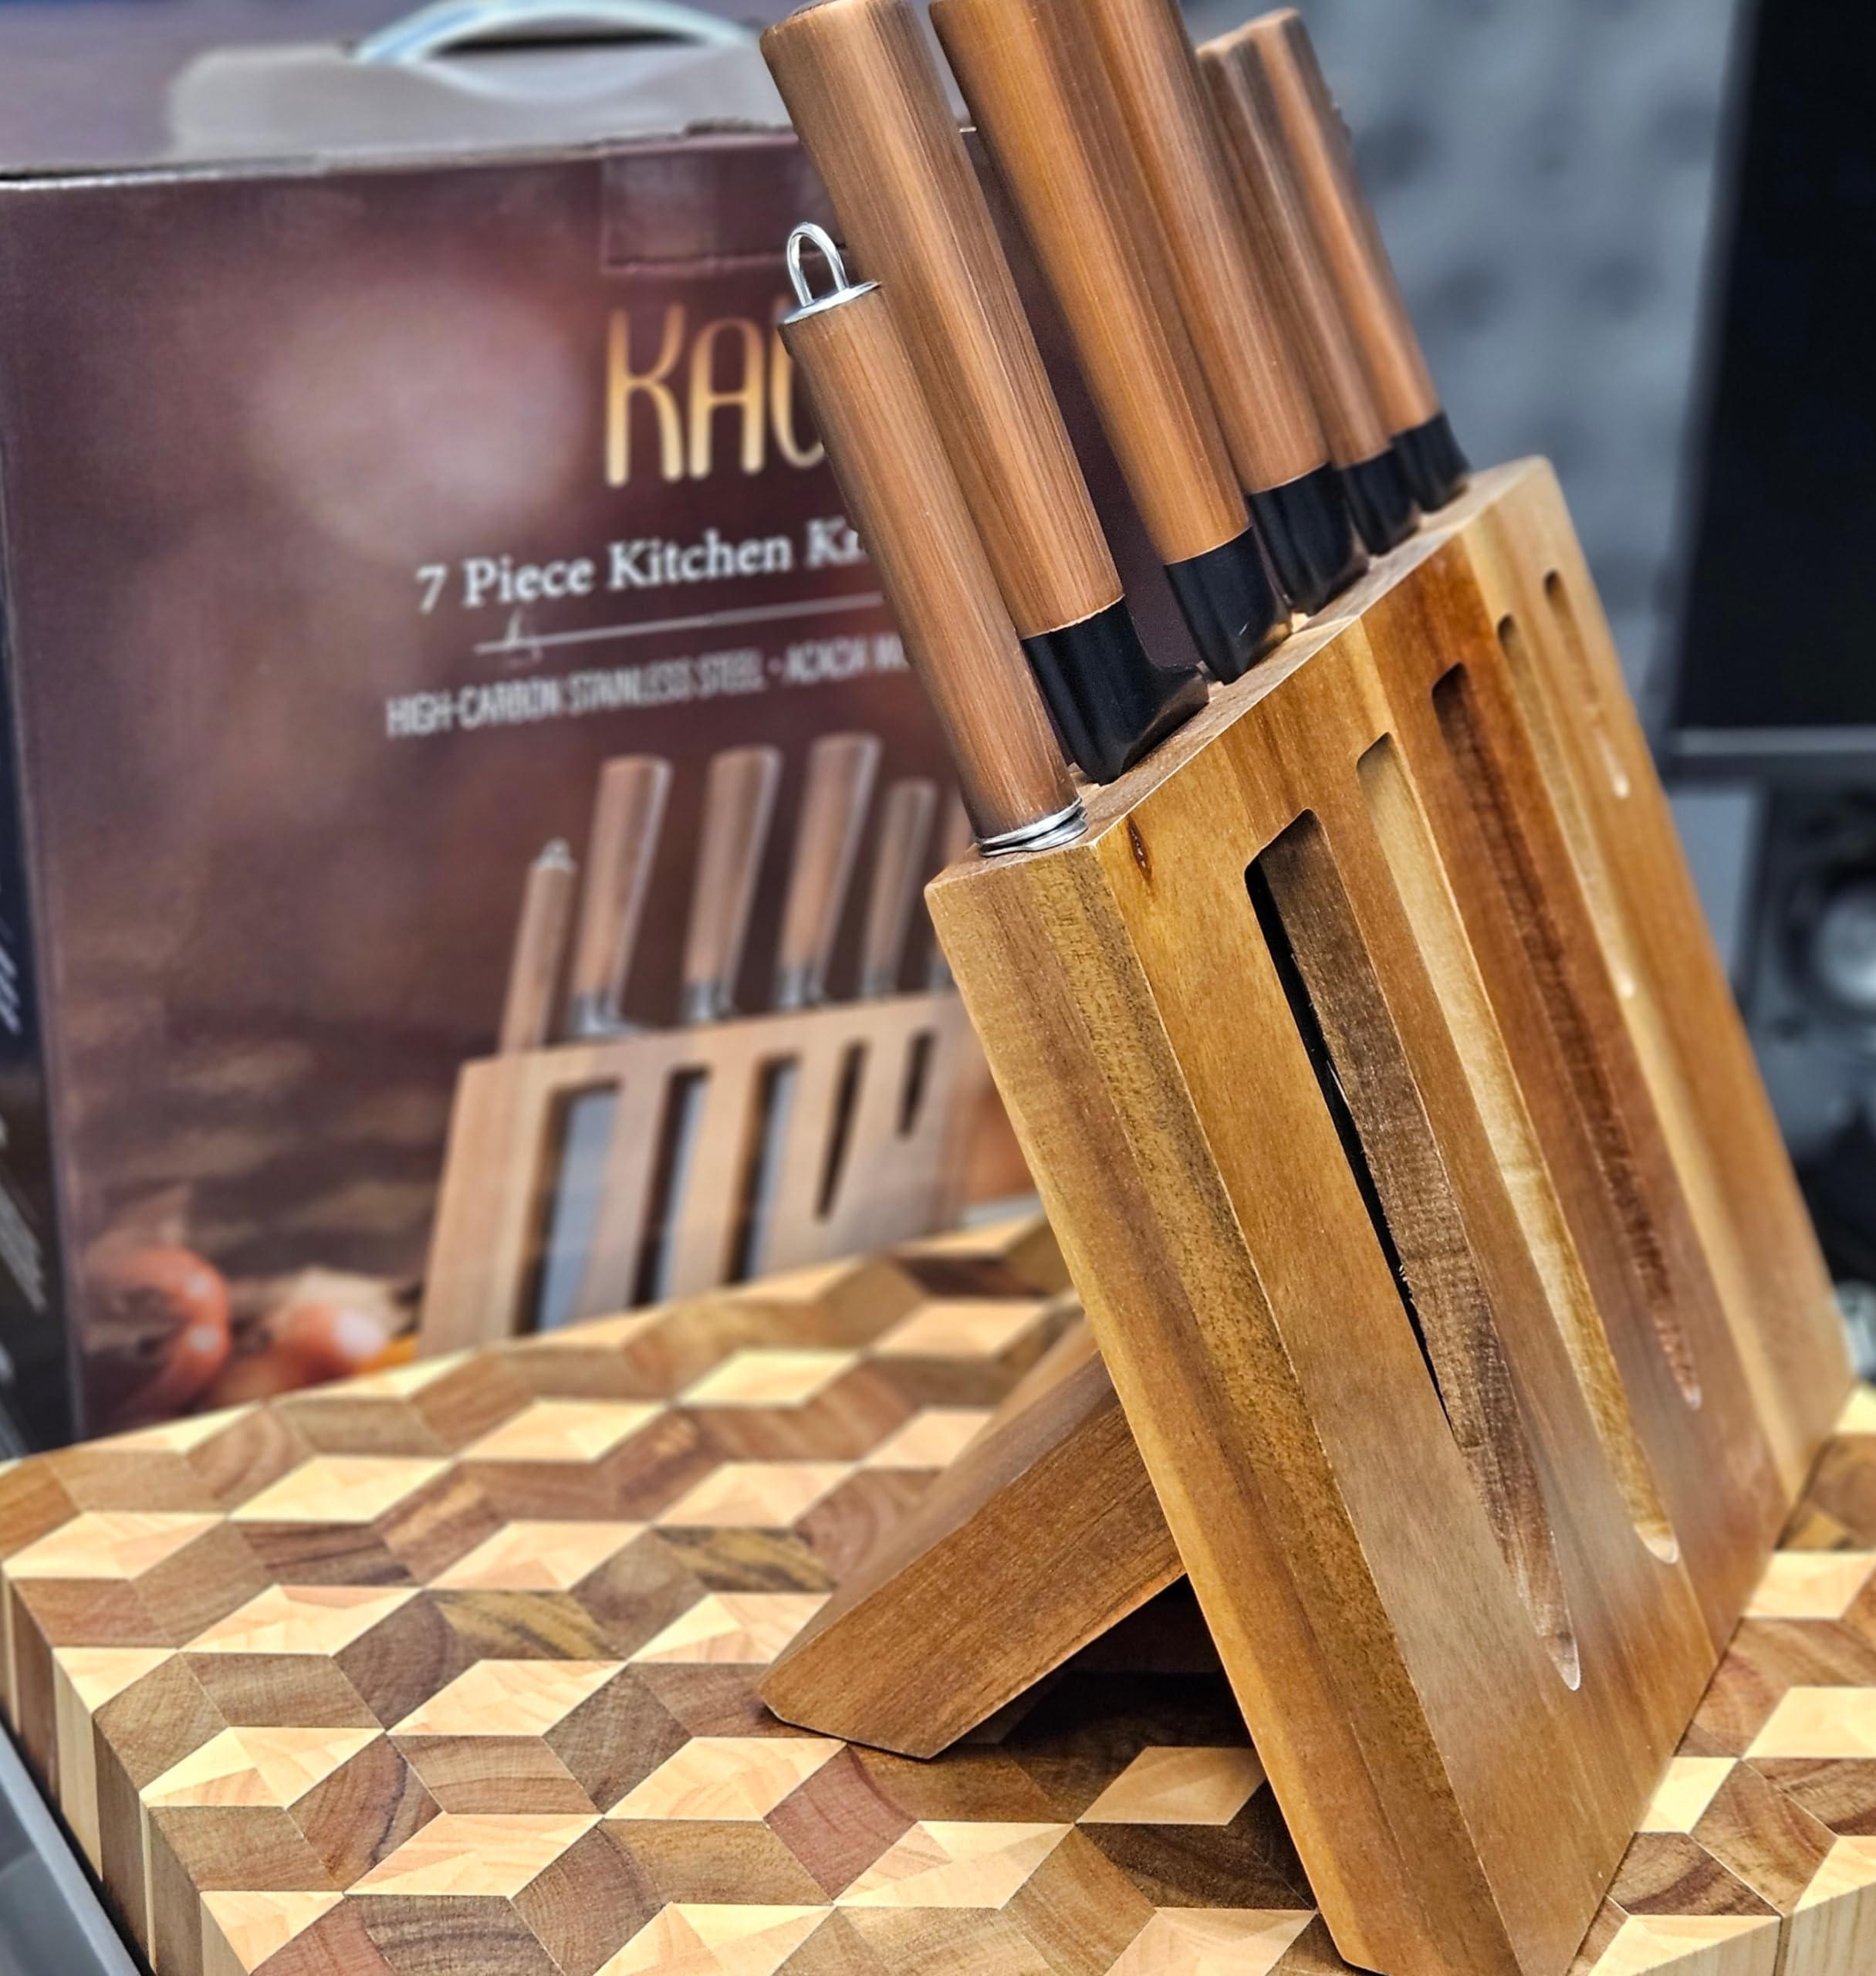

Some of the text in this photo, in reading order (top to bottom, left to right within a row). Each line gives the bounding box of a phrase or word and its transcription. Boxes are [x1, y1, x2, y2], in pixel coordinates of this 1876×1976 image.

[416, 563, 448, 614] 7
[462, 553, 594, 608] Piece
[608, 528, 794, 591] Kitchen
[387, 675, 562, 737] HIGH-CARBON
[567, 657, 693, 716] STAINLESS
[697, 647, 763, 699] STEEL
